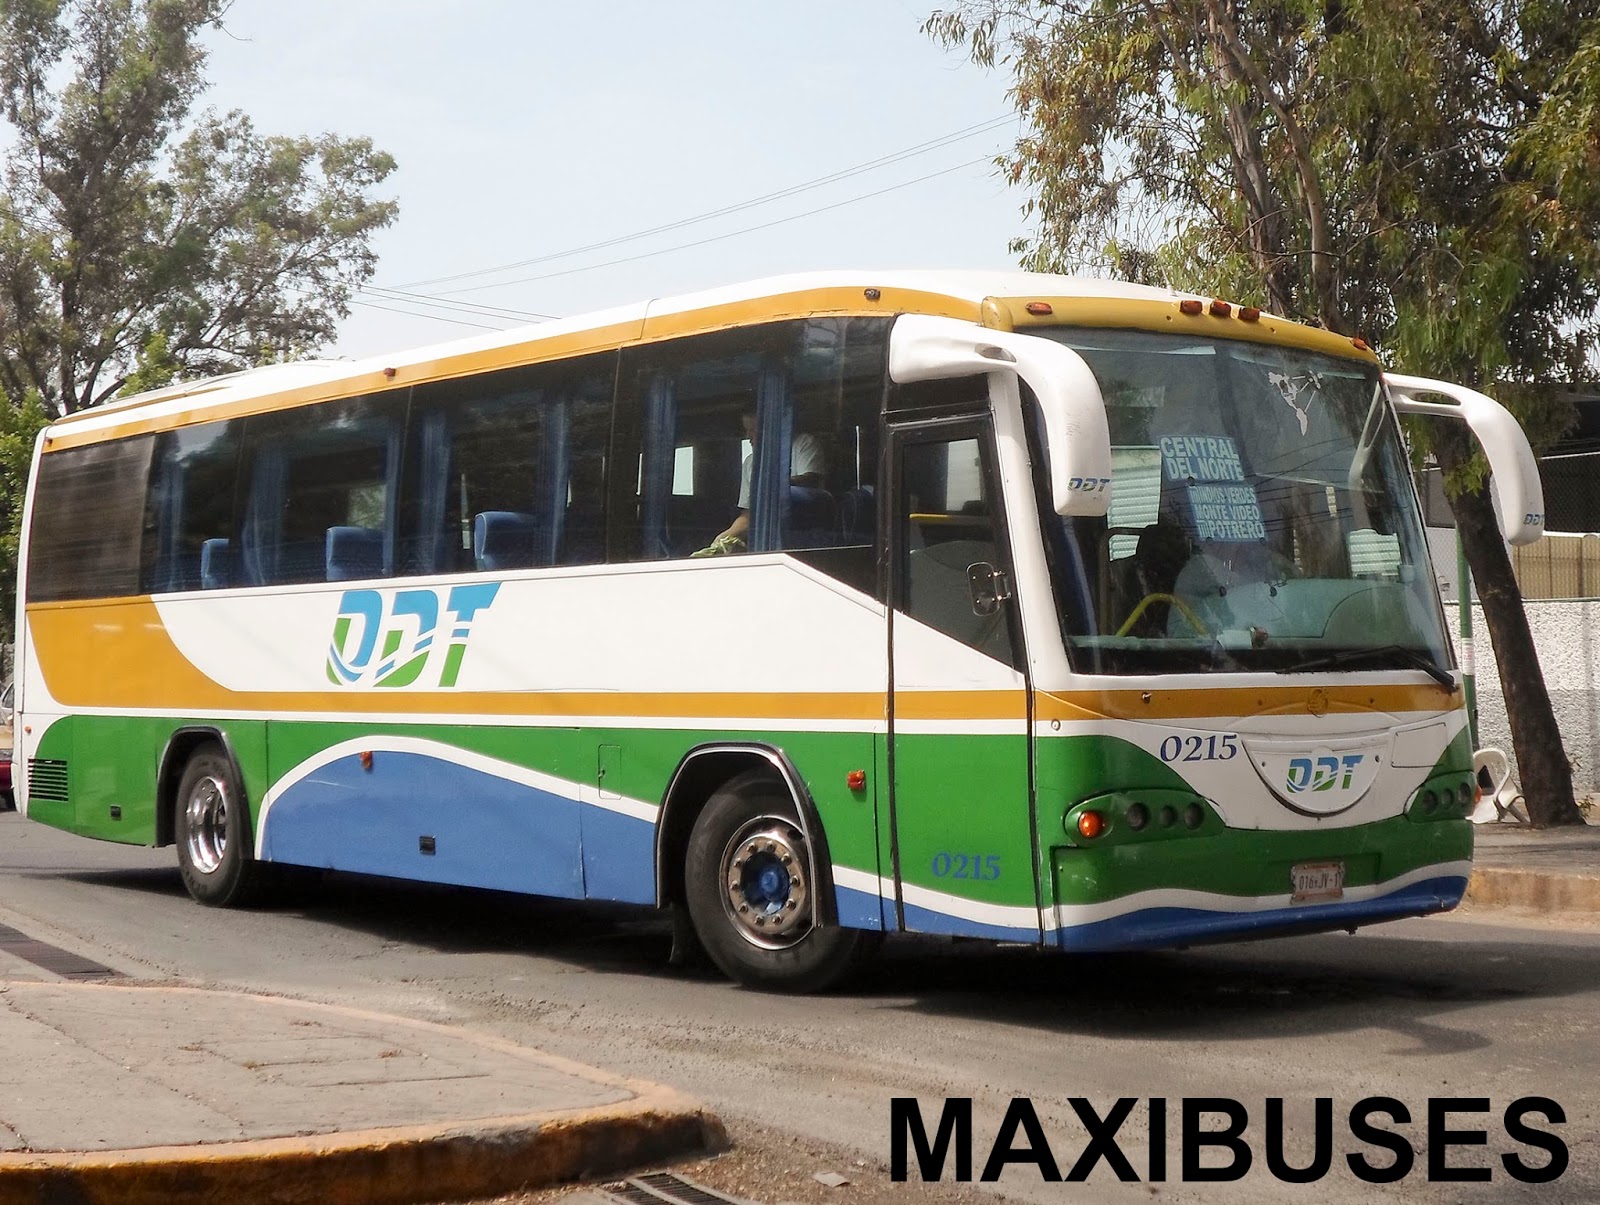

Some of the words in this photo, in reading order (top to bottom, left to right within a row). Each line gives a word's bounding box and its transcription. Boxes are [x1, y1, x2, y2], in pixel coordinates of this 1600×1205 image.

[1160, 437, 1240, 460] CENTRAL
[1166, 458, 1198, 480] DEL
[1198, 458, 1245, 480] NORTE
[1225, 487, 1257, 504] VERDES
[1195, 504, 1229, 520] MONTE
[1228, 505, 1261, 521] VIDEO
[1208, 520, 1265, 539] POTRERO
[1160, 733, 1239, 762] 0215
[931, 851, 1001, 881] 0215
